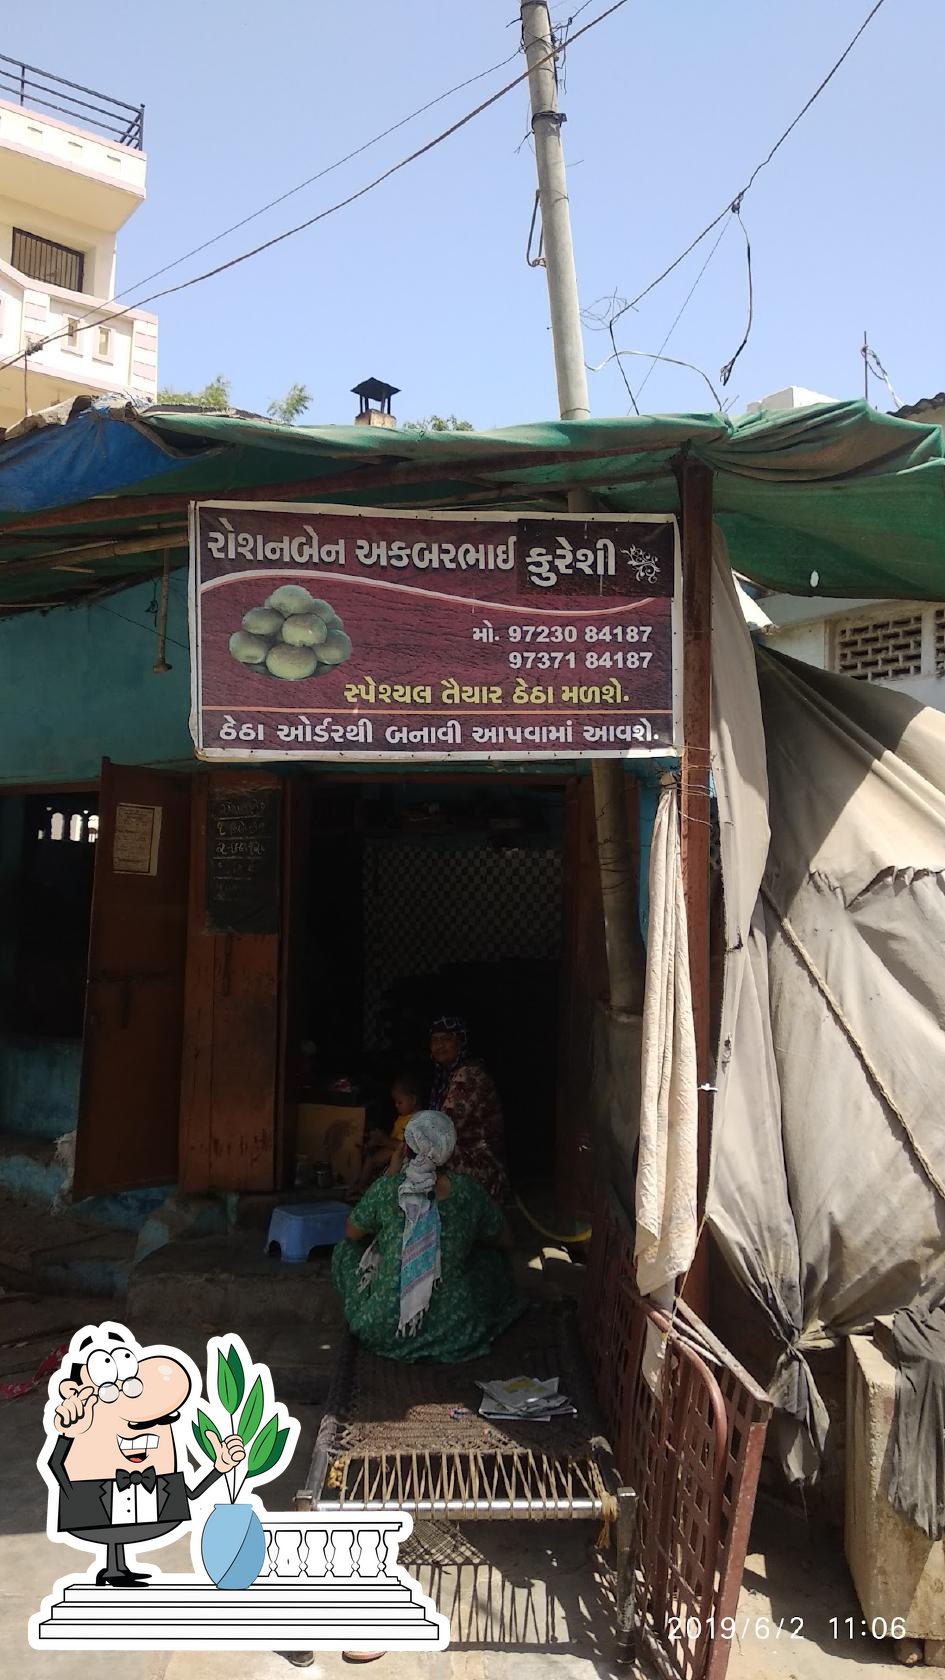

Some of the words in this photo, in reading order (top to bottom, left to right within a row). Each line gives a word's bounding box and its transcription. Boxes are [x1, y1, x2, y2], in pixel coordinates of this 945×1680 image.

[208, 517, 346, 565] રોશનબેન
[355, 535, 517, 571] અકબરભાઈ
[525, 536, 616, 587] કુરેશી
[472, 620, 500, 643] મો.
[508, 625, 578, 643] 97230
[584, 625, 653, 643] 84187
[508, 651, 577, 669] 97371
[585, 651, 653, 669] 84187
[343, 675, 432, 704] સ્પેશ્યલ
[441, 677, 503, 704] તૈયાર
[512, 678, 553, 704] ઠેઠા
[561, 678, 630, 704] મળશે.
[219, 715, 264, 742] ઠેઠા
[277, 715, 373, 743] ઓર્ડરથી
[385, 719, 462, 744] બનાવી
[472, 719, 573, 743] આપવામાં
[583, 717, 660, 743] આવશે.
